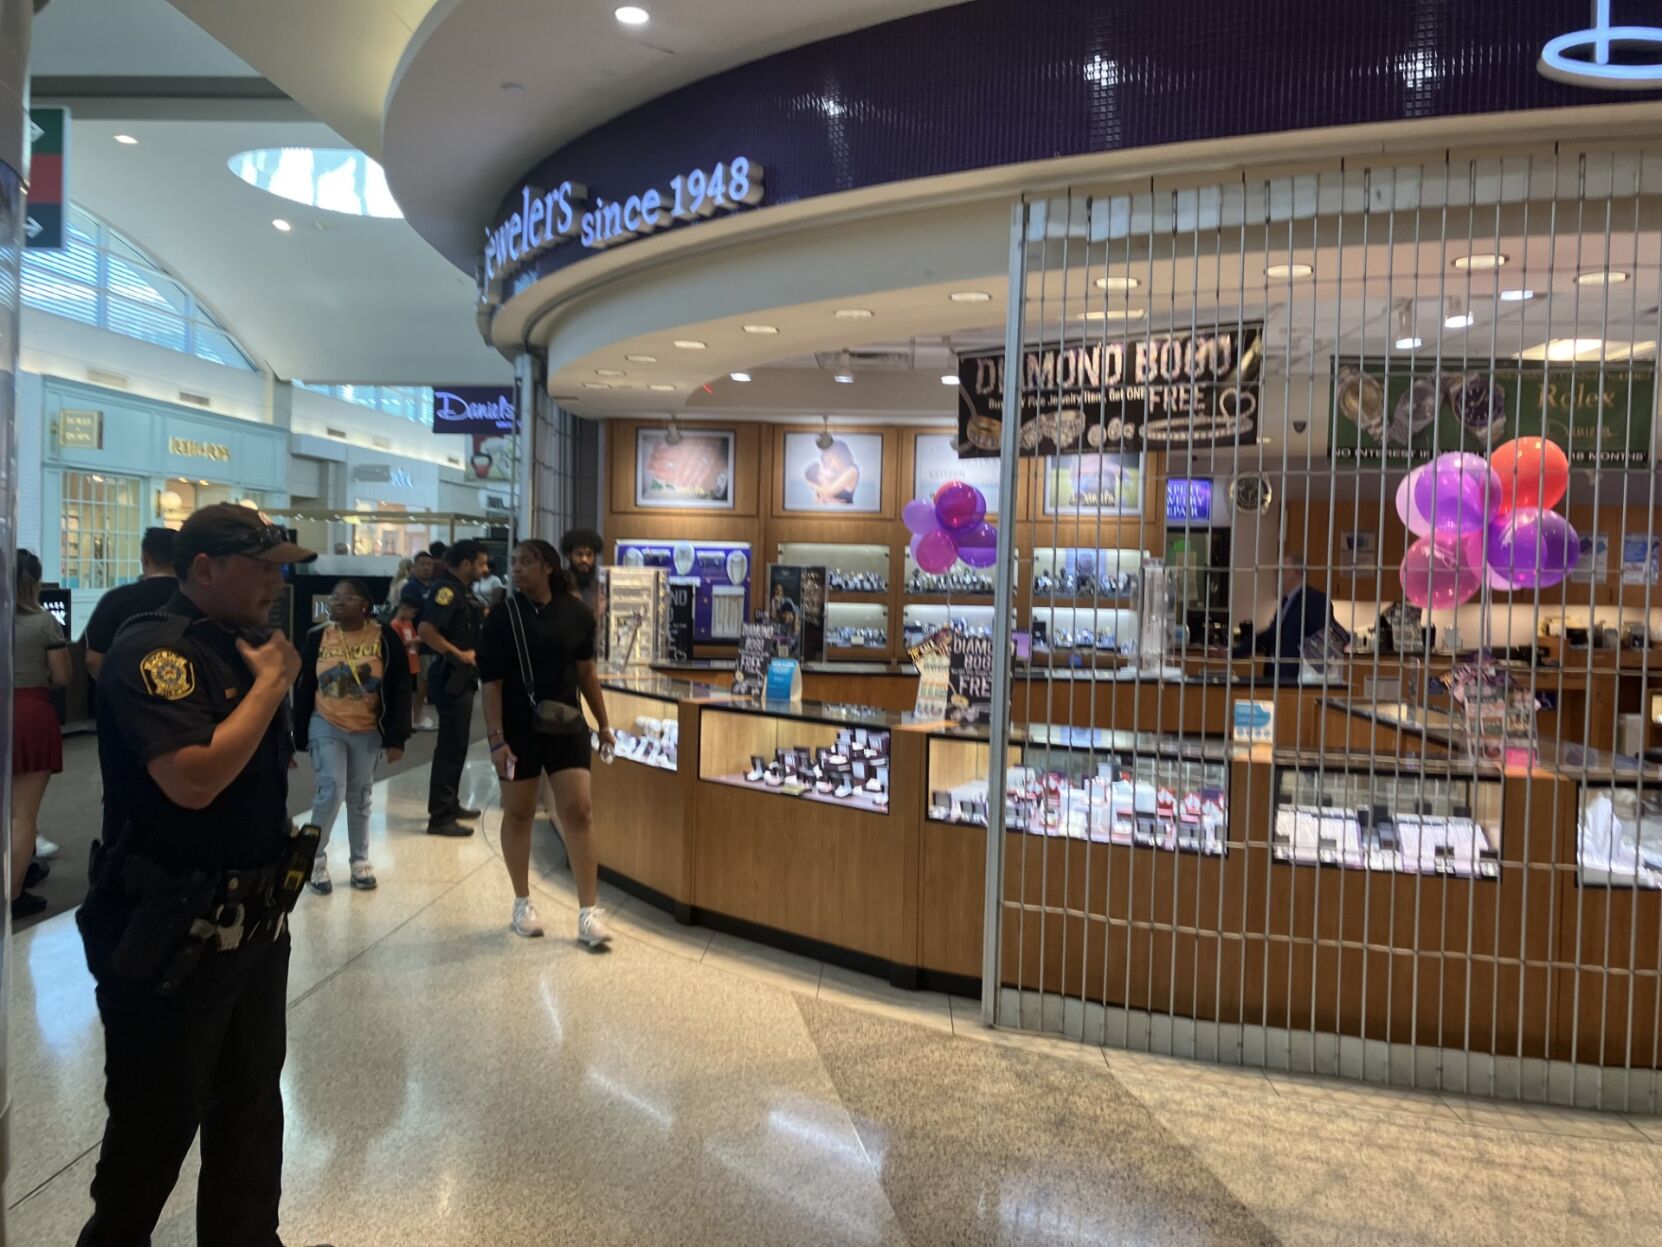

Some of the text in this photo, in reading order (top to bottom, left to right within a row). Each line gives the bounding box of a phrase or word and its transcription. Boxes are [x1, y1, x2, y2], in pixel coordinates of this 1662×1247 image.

[581, 188, 661, 248] since
[670, 156, 750, 218] 1948
[975, 343, 1125, 396] DIMOND
[1150, 383, 1206, 413] FREE
[959, 676, 992, 698] FRE
